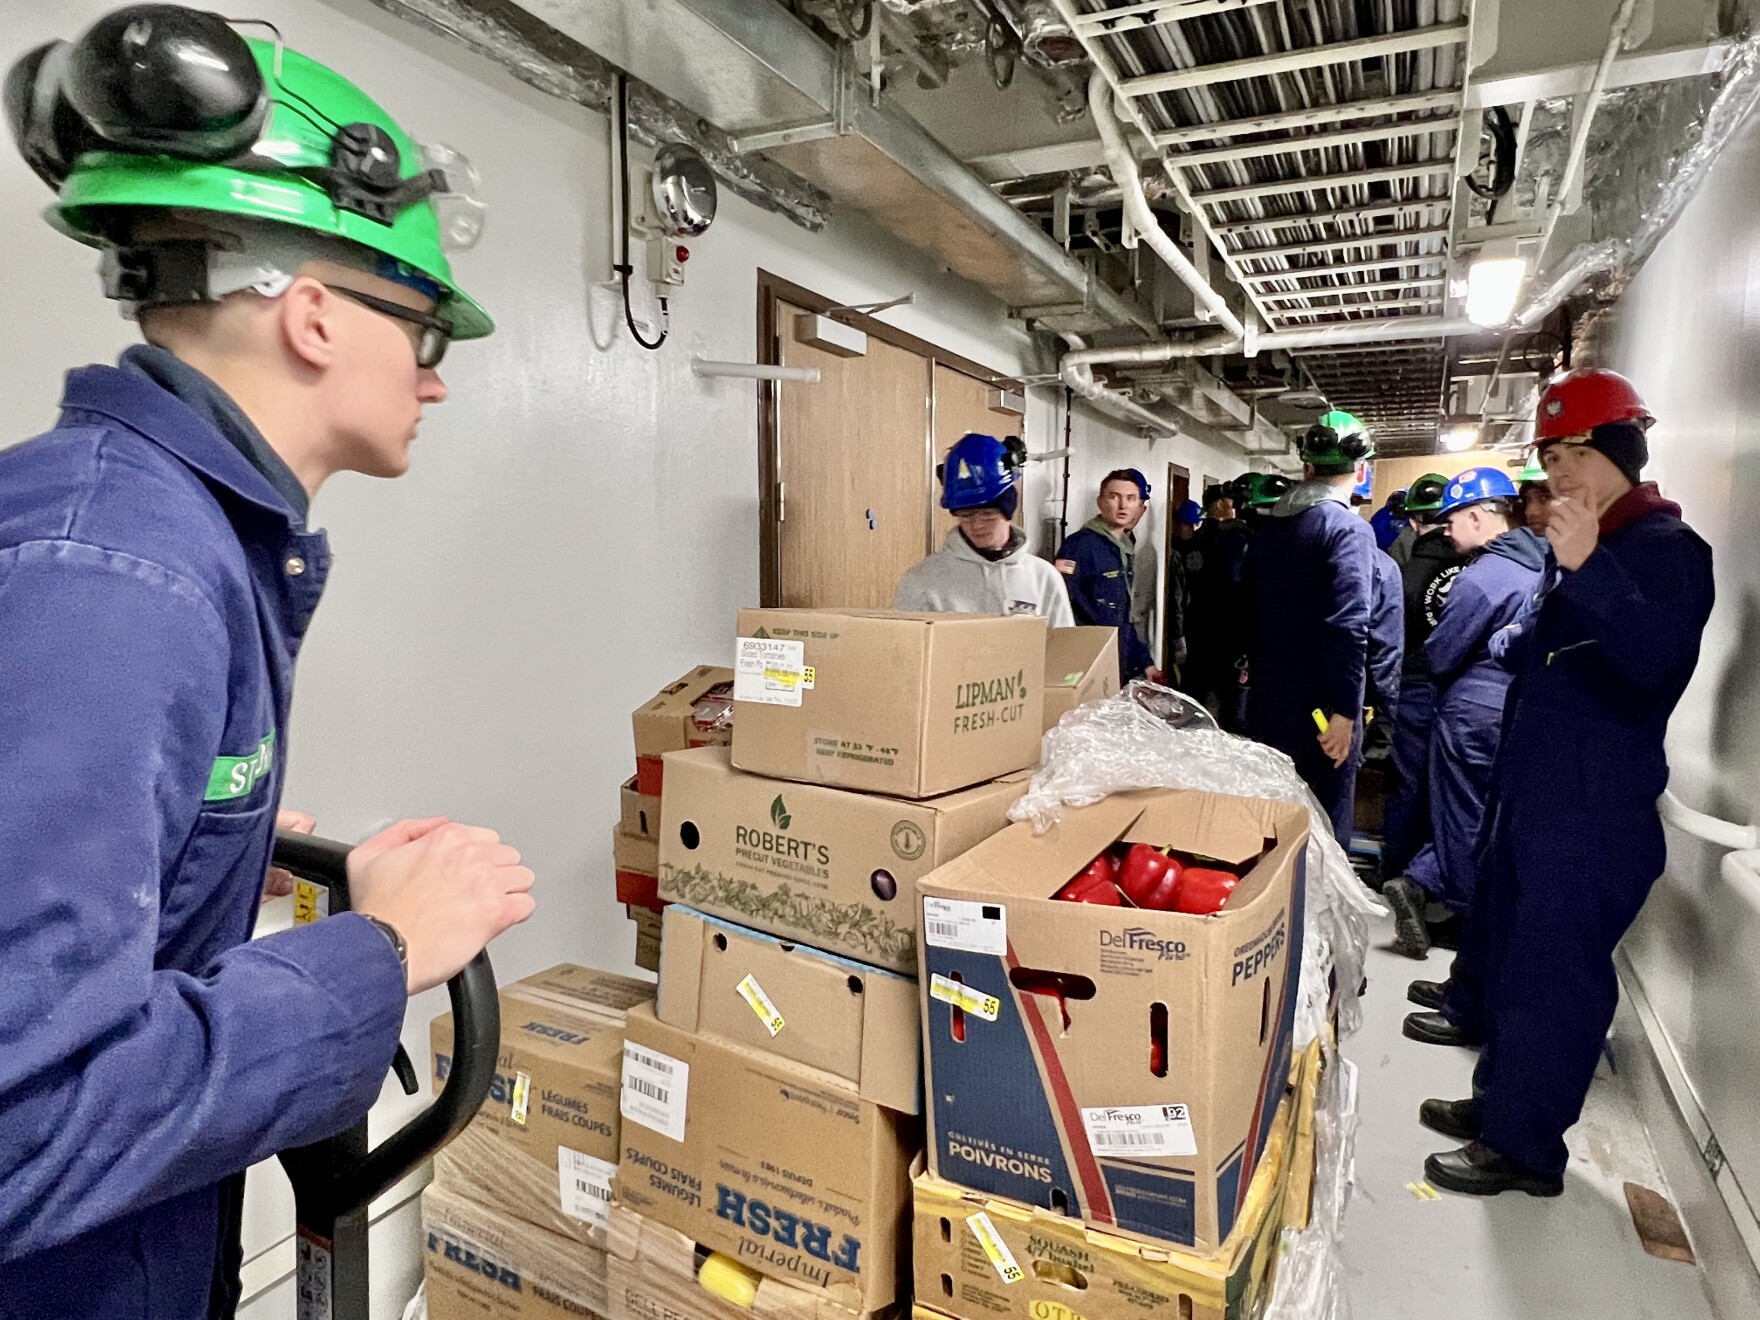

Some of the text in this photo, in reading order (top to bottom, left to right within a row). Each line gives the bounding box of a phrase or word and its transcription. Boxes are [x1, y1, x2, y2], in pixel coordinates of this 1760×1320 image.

[1424, 576, 1443, 604] WORK
[1440, 566, 1461, 578] LIKE
[743, 642, 786, 652] 6933147
[955, 676, 1016, 710] LIPMAN
[954, 703, 1024, 734] FRESH-CUT
[736, 826, 830, 865] ROBERT'S
[736, 848, 830, 880] PRECUT VEGETABLES
[1232, 922, 1286, 986] PEPPERS
[983, 998, 996, 1014] 55
[542, 1104, 570, 1122] FRAIS
[1168, 1107, 1186, 1120] 92
[626, 1147, 702, 1191] FRAIS COUPÉS
[782, 1168, 813, 1187] DEPUIS
[949, 1141, 1052, 1184] POIVRONS
[649, 1174, 701, 1208] LÉGUMES
[715, 1183, 862, 1273] FRESH
[738, 1236, 831, 1288] Imperial
[1030, 1234, 1090, 1262] SQUASH
[1050, 1250, 1096, 1274] bushel
[1004, 1266, 1021, 1280] 55
